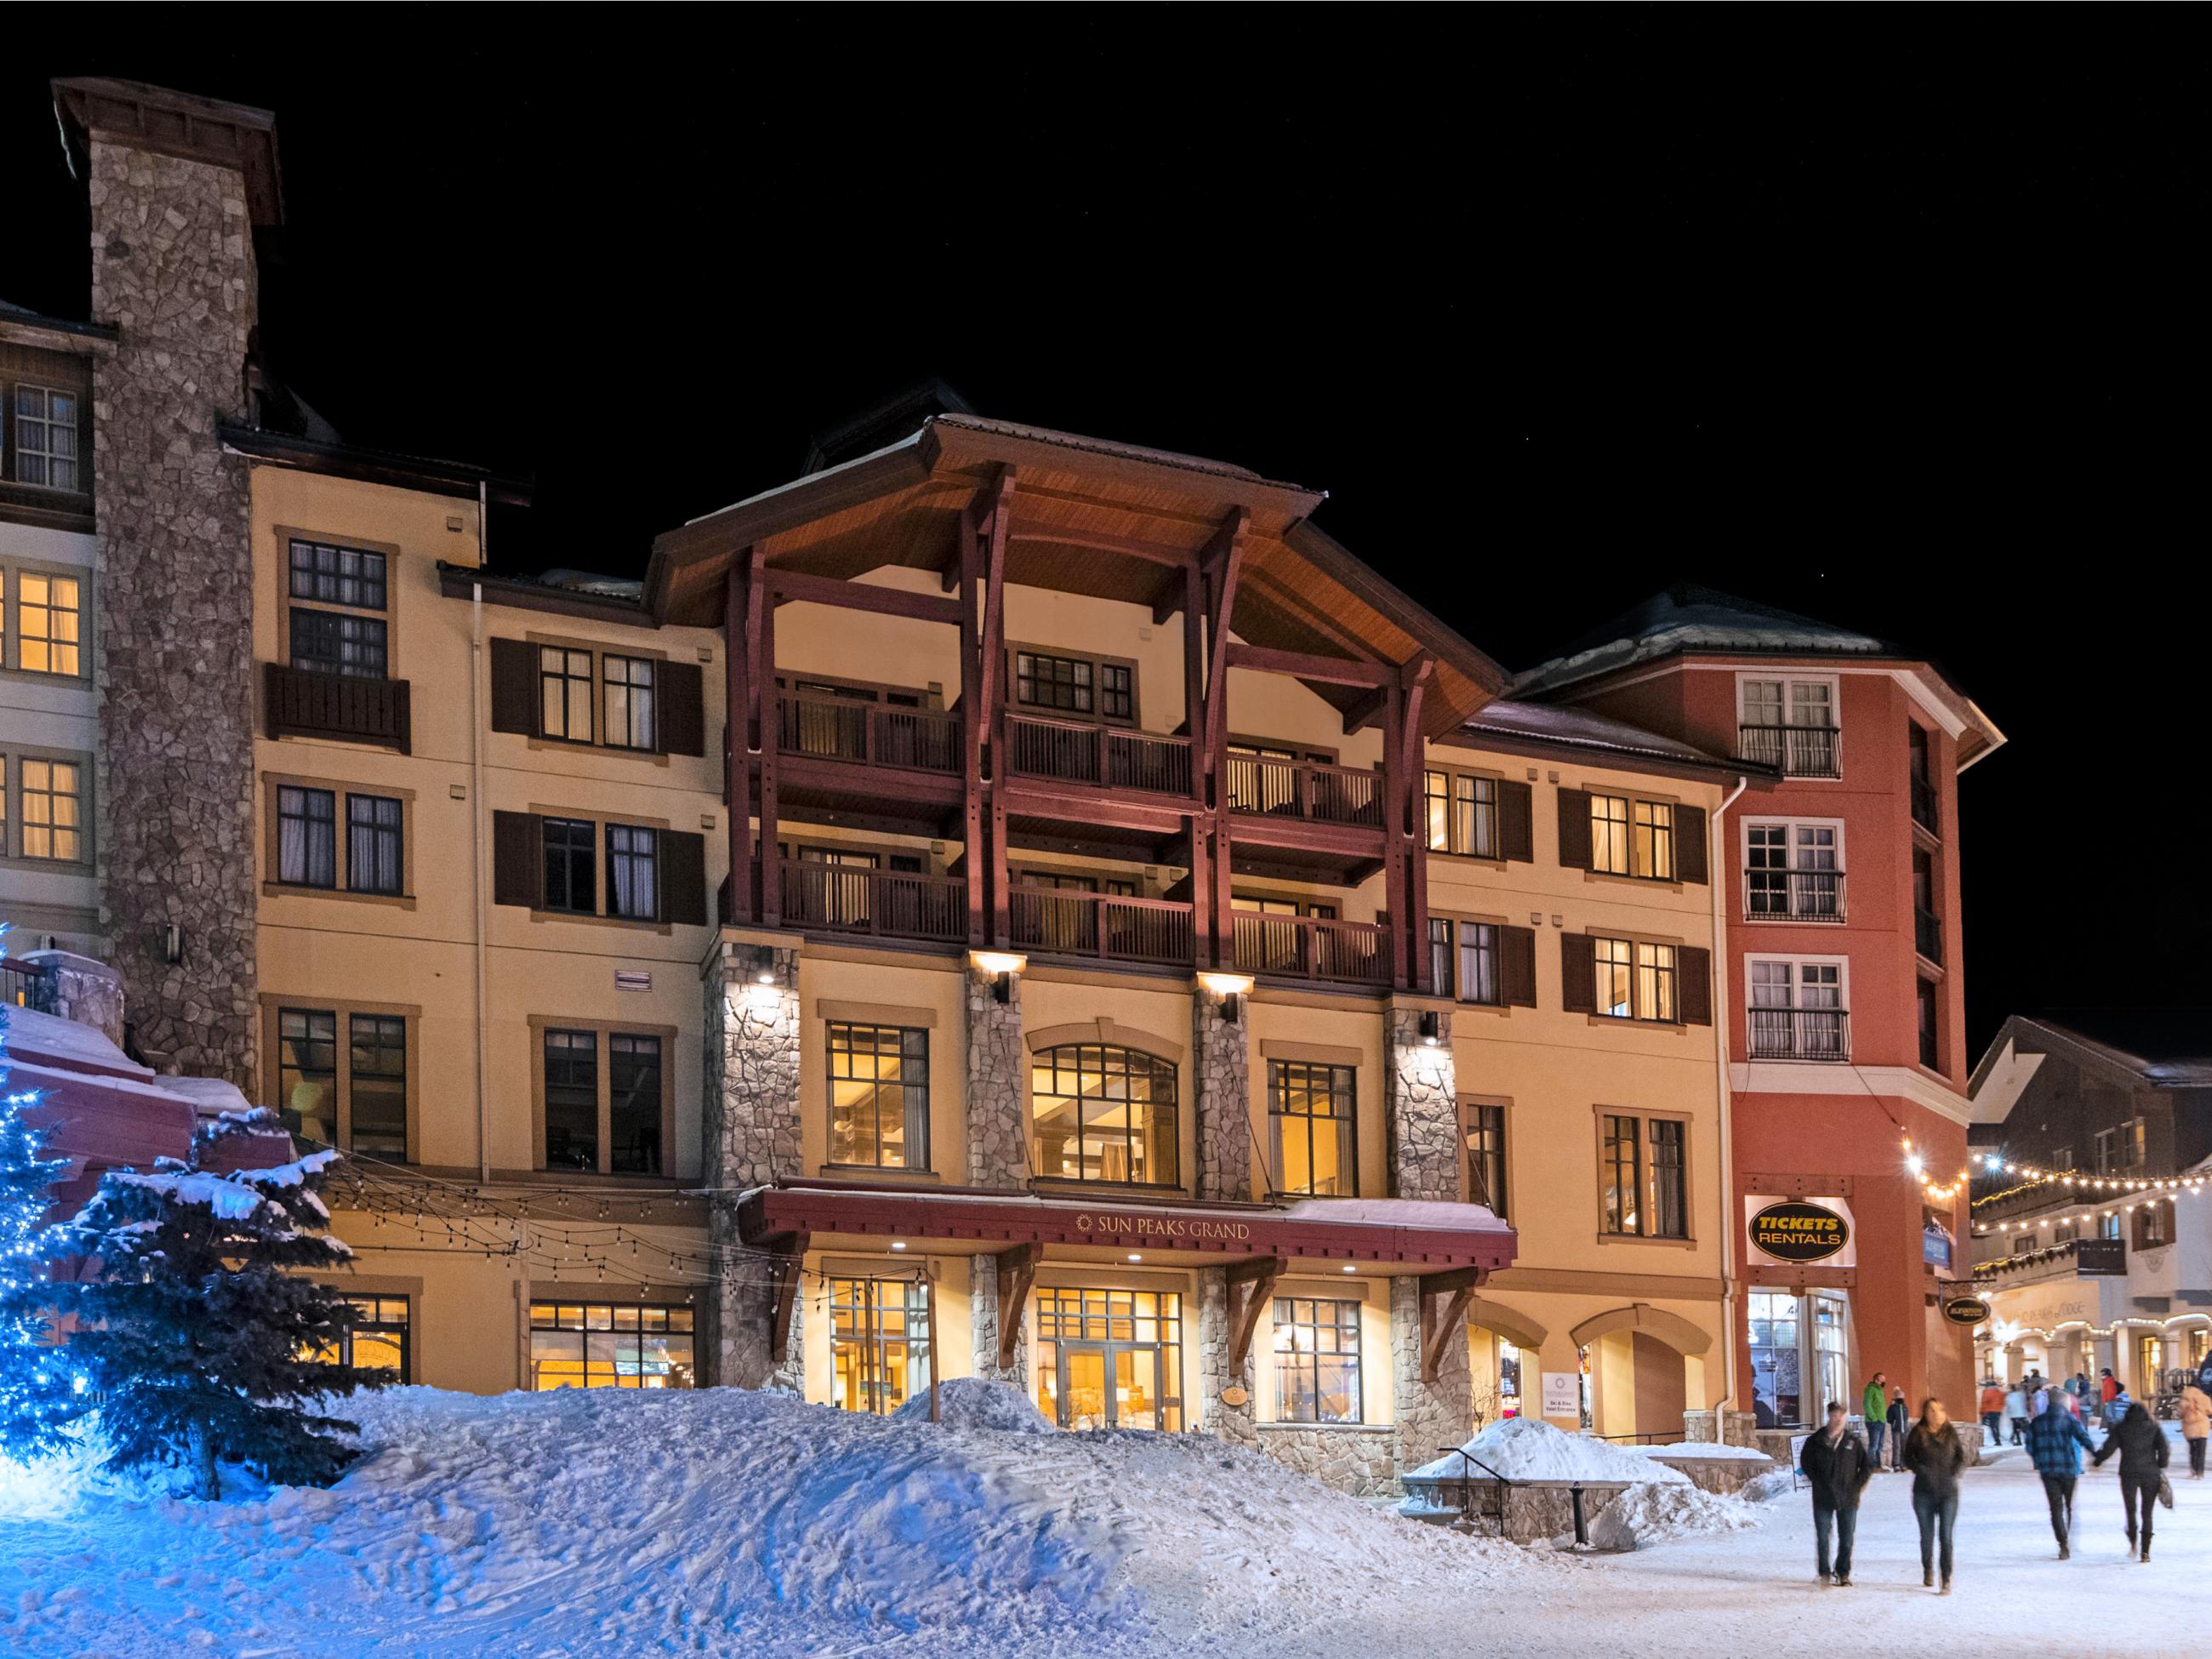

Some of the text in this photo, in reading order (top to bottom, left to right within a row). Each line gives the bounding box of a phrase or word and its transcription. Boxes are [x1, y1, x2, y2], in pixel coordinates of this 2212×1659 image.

[1097, 1216, 1250, 1240] SUN PEAKS GRAND
[1759, 1216, 1839, 1231] TICKETS
[1759, 1233, 1841, 1245] RENTALS
